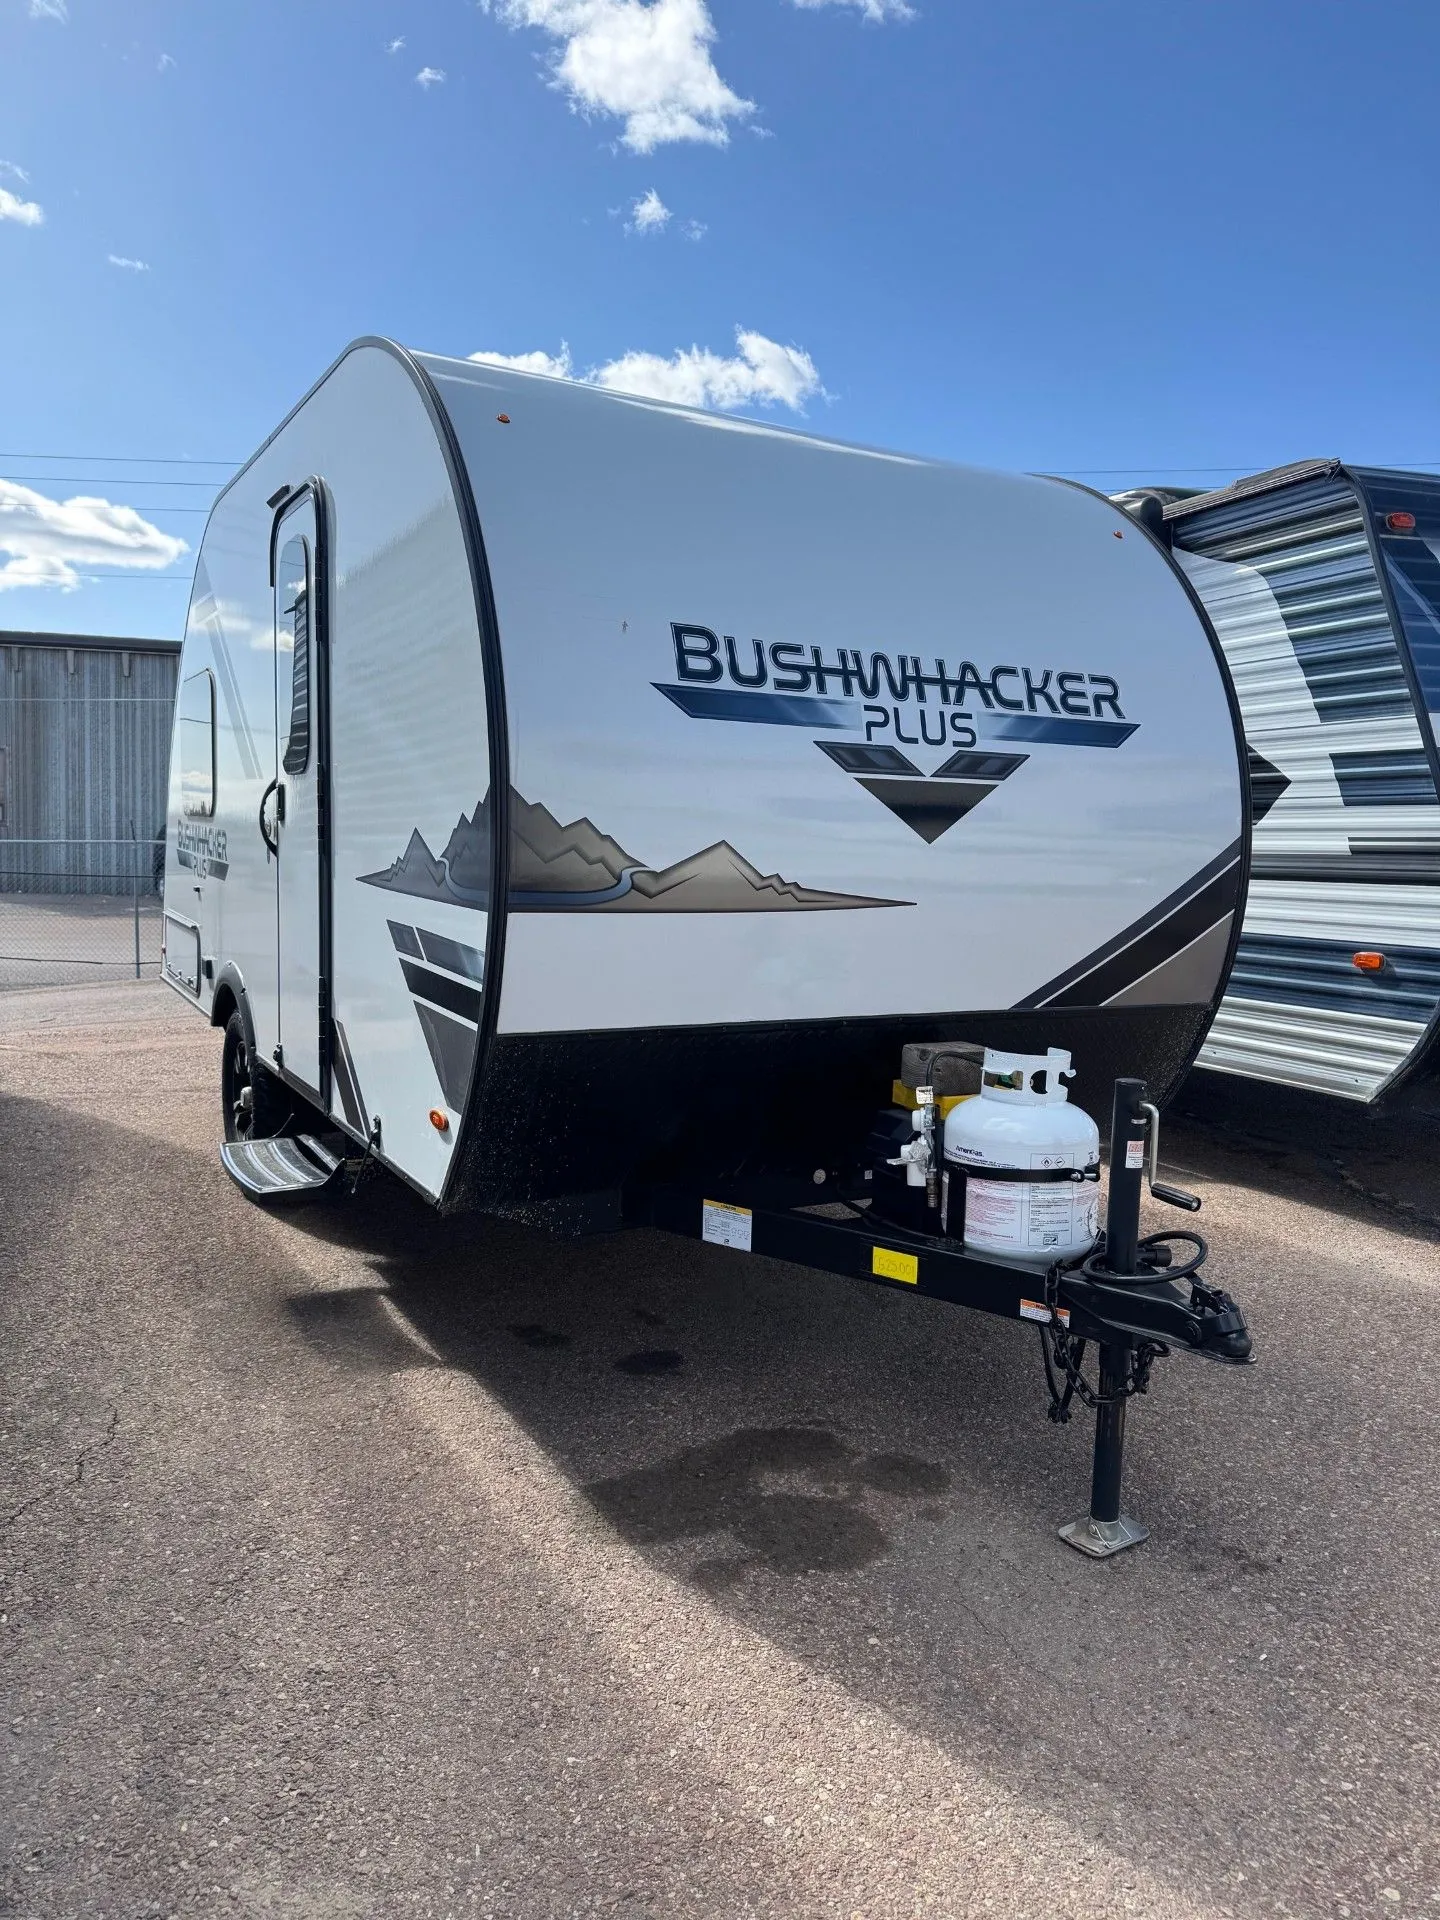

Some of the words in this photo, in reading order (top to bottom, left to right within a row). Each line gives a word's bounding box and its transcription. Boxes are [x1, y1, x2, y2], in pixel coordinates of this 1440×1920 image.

[670, 622, 1126, 719] BUSHWHACKER
[863, 704, 977, 748] PLUS
[178, 819, 227, 861] BUSHWHACKER
